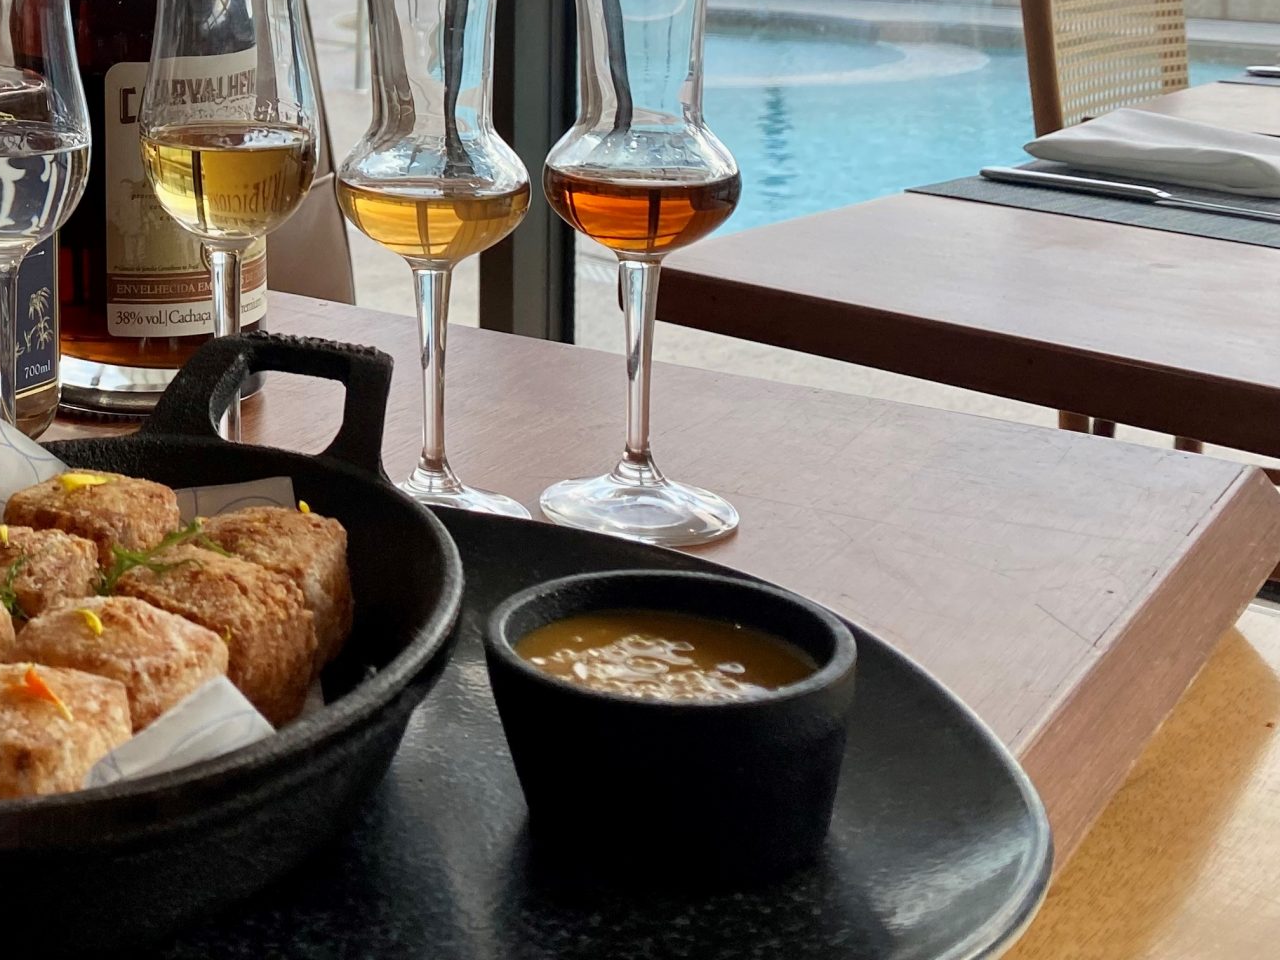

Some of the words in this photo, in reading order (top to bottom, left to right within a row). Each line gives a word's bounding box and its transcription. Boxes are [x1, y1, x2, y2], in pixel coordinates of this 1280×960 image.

[116, 283, 196, 294] ENVELHECIDA
[115, 310, 144, 325] 38%
[145, 309, 165, 325] vol.
[168, 308, 211, 326] Cachaça
[24, 359, 51, 379] 700ml
